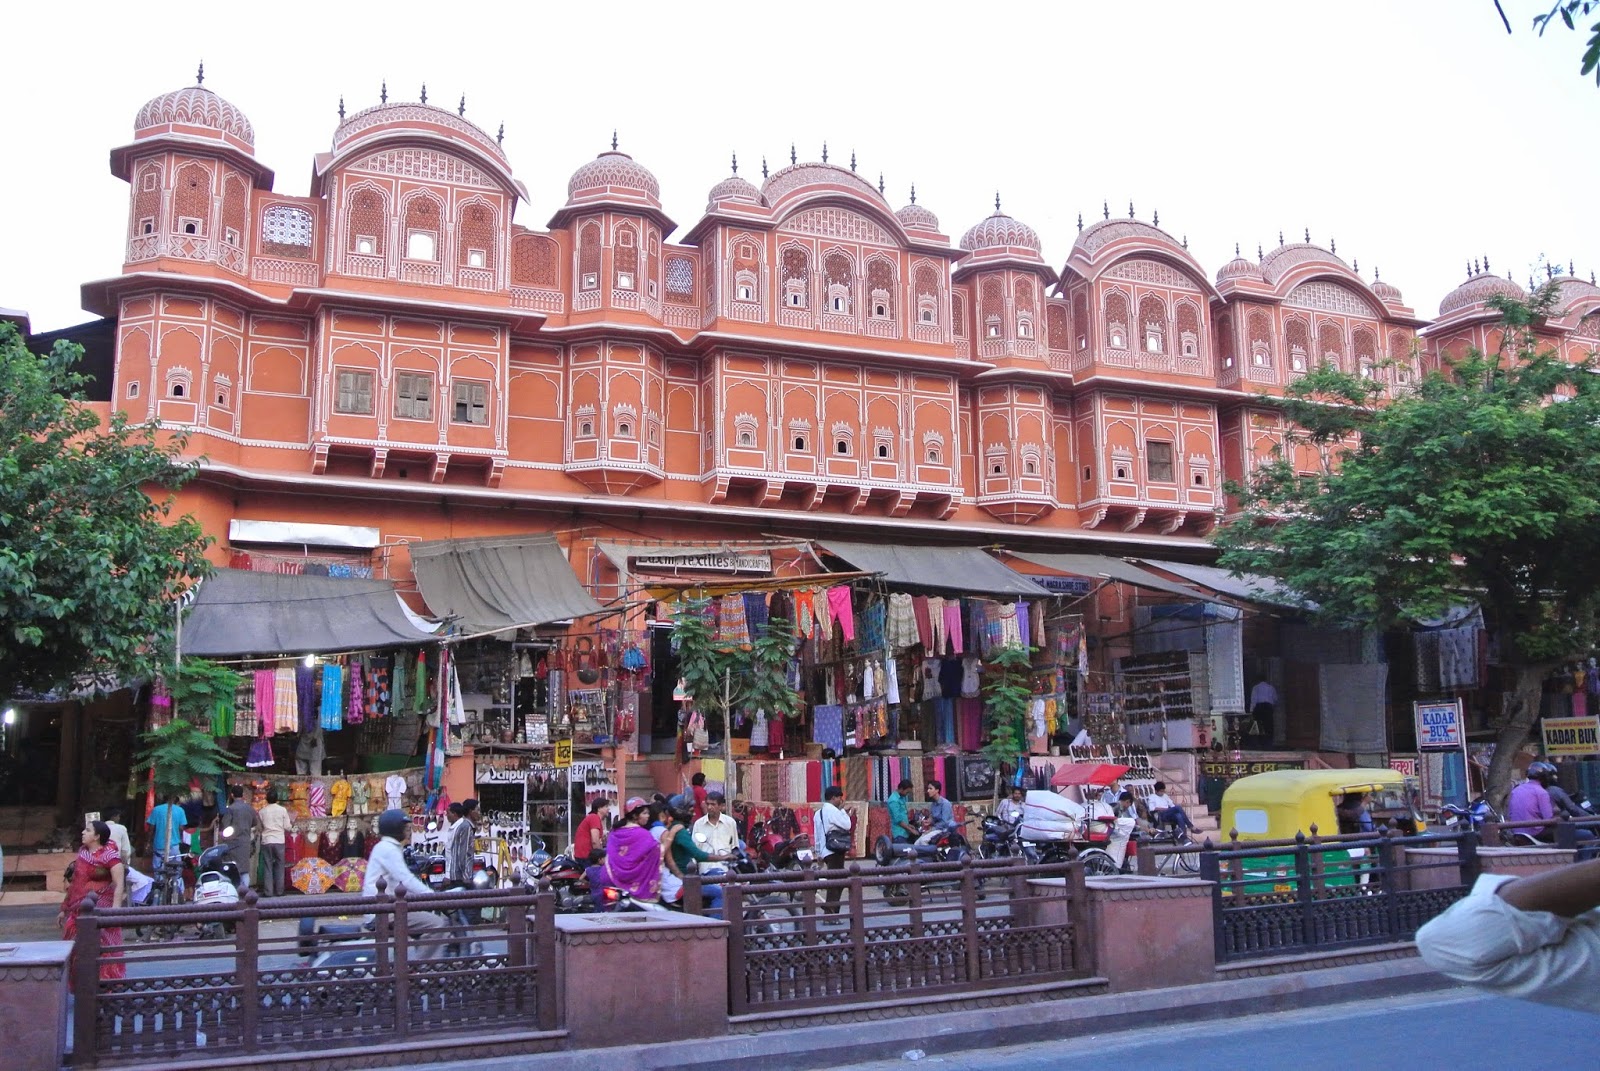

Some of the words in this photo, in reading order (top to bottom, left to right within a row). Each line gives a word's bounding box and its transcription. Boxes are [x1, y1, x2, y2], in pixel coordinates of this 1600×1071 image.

[638, 557, 676, 565] Laxm
[682, 553, 729, 567] Textiles
[1422, 712, 1455, 725] KADAR
[1430, 725, 1449, 737] BUX
[1545, 729, 1576, 744] KADAR
[1578, 728, 1598, 744] BUX
[490, 765, 528, 782] Jaipu
